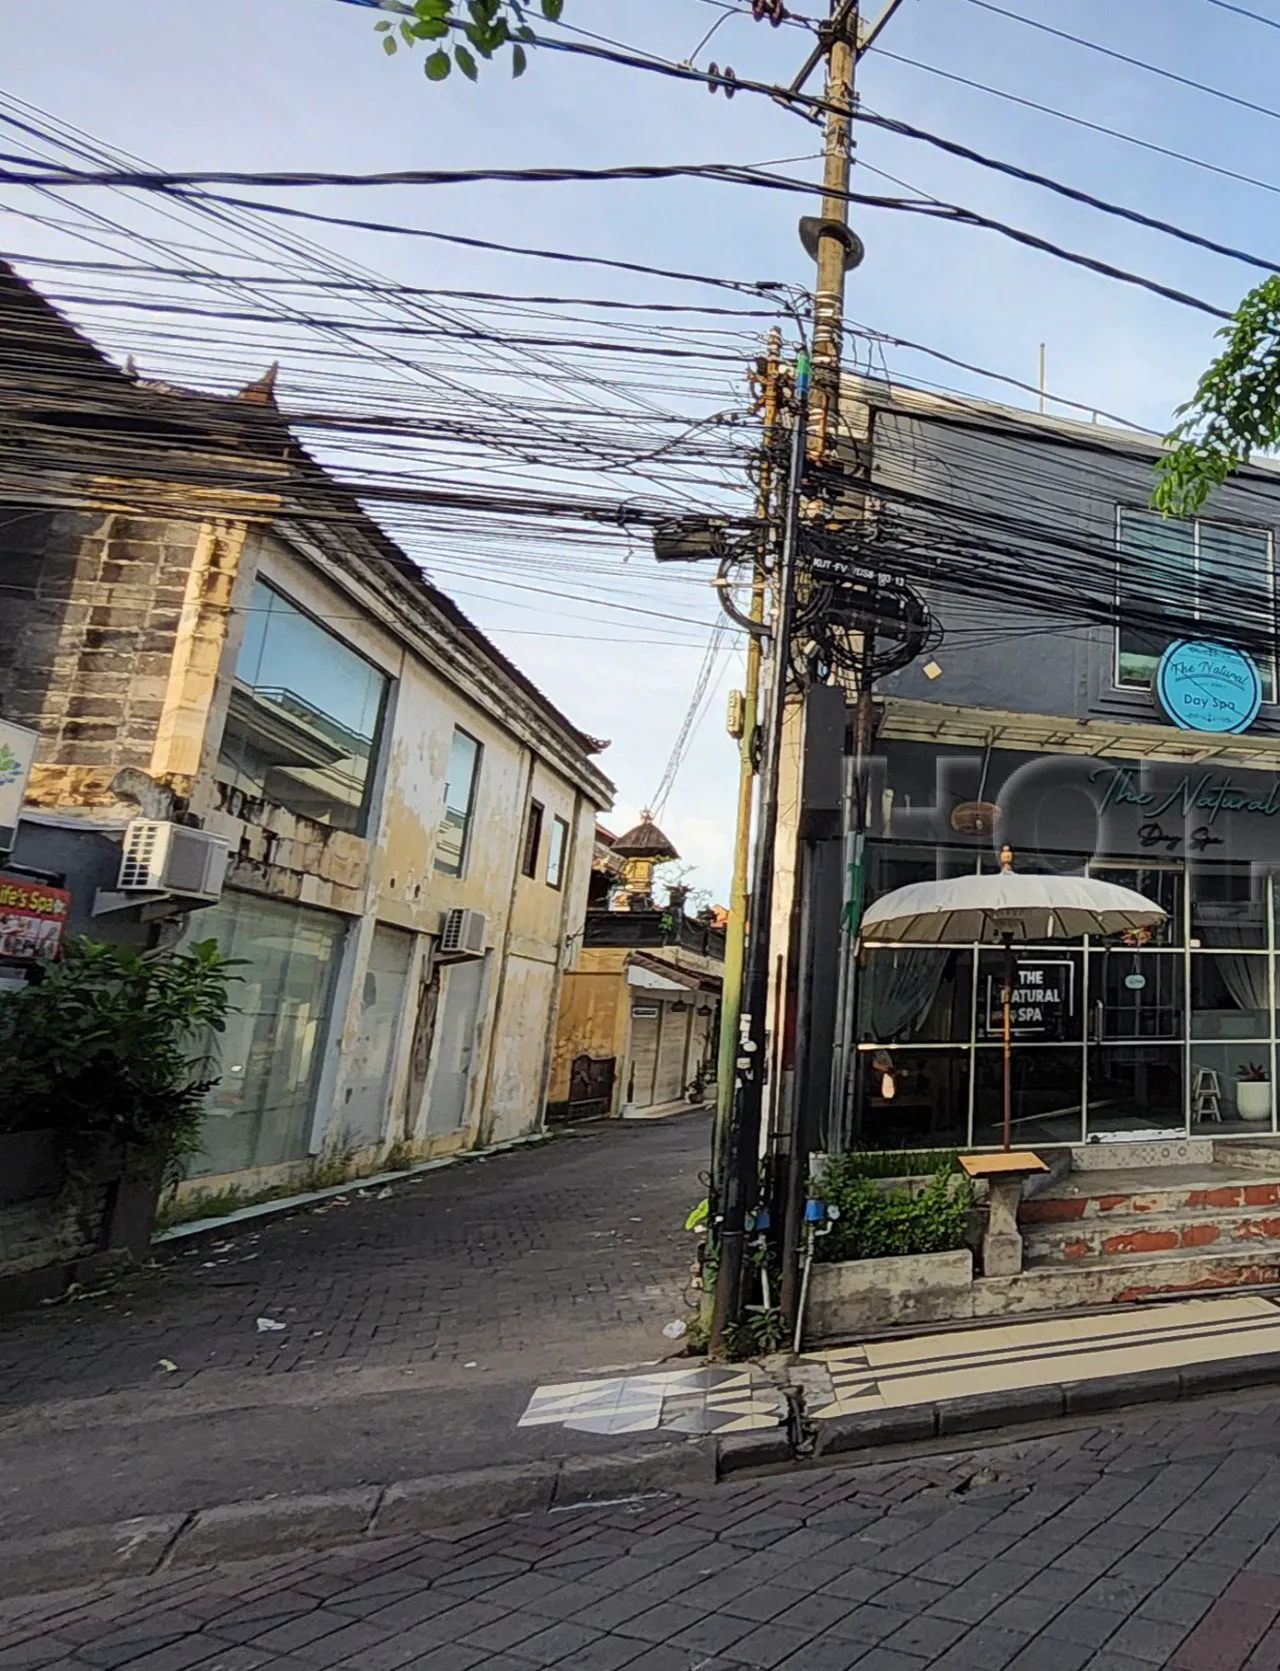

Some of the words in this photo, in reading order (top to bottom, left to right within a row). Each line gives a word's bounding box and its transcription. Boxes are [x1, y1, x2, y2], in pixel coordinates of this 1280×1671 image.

[1170, 661, 1195, 676] The
[1199, 661, 1249, 686] Natural
[1184, 694, 1208, 709] Day
[1212, 697, 1235, 711] Spa
[1089, 764, 1153, 817] The
[1144, 772, 1280, 825] Natural
[1018, 970, 1043, 984] THE
[1018, 1007, 1042, 1021] SPA
